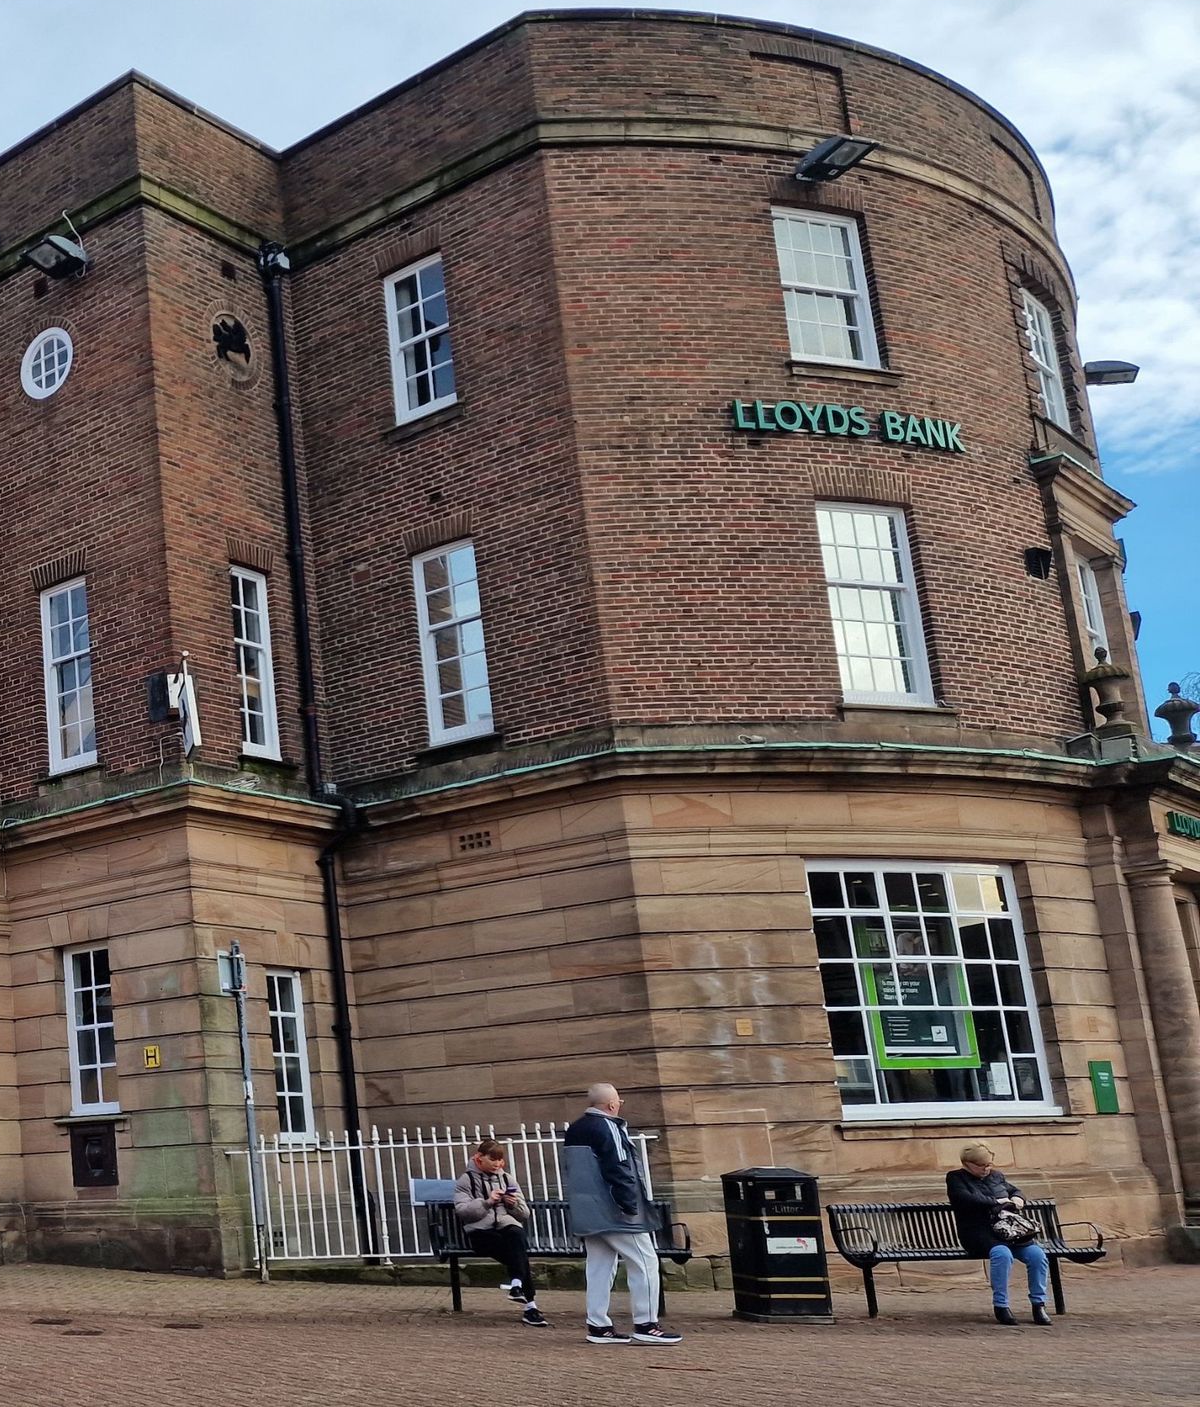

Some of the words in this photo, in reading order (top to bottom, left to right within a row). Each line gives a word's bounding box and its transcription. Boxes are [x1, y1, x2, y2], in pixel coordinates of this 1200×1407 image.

[733, 399, 871, 436] LLOYDS
[882, 410, 968, 453] BANK
[146, 1048, 157, 1066] H
